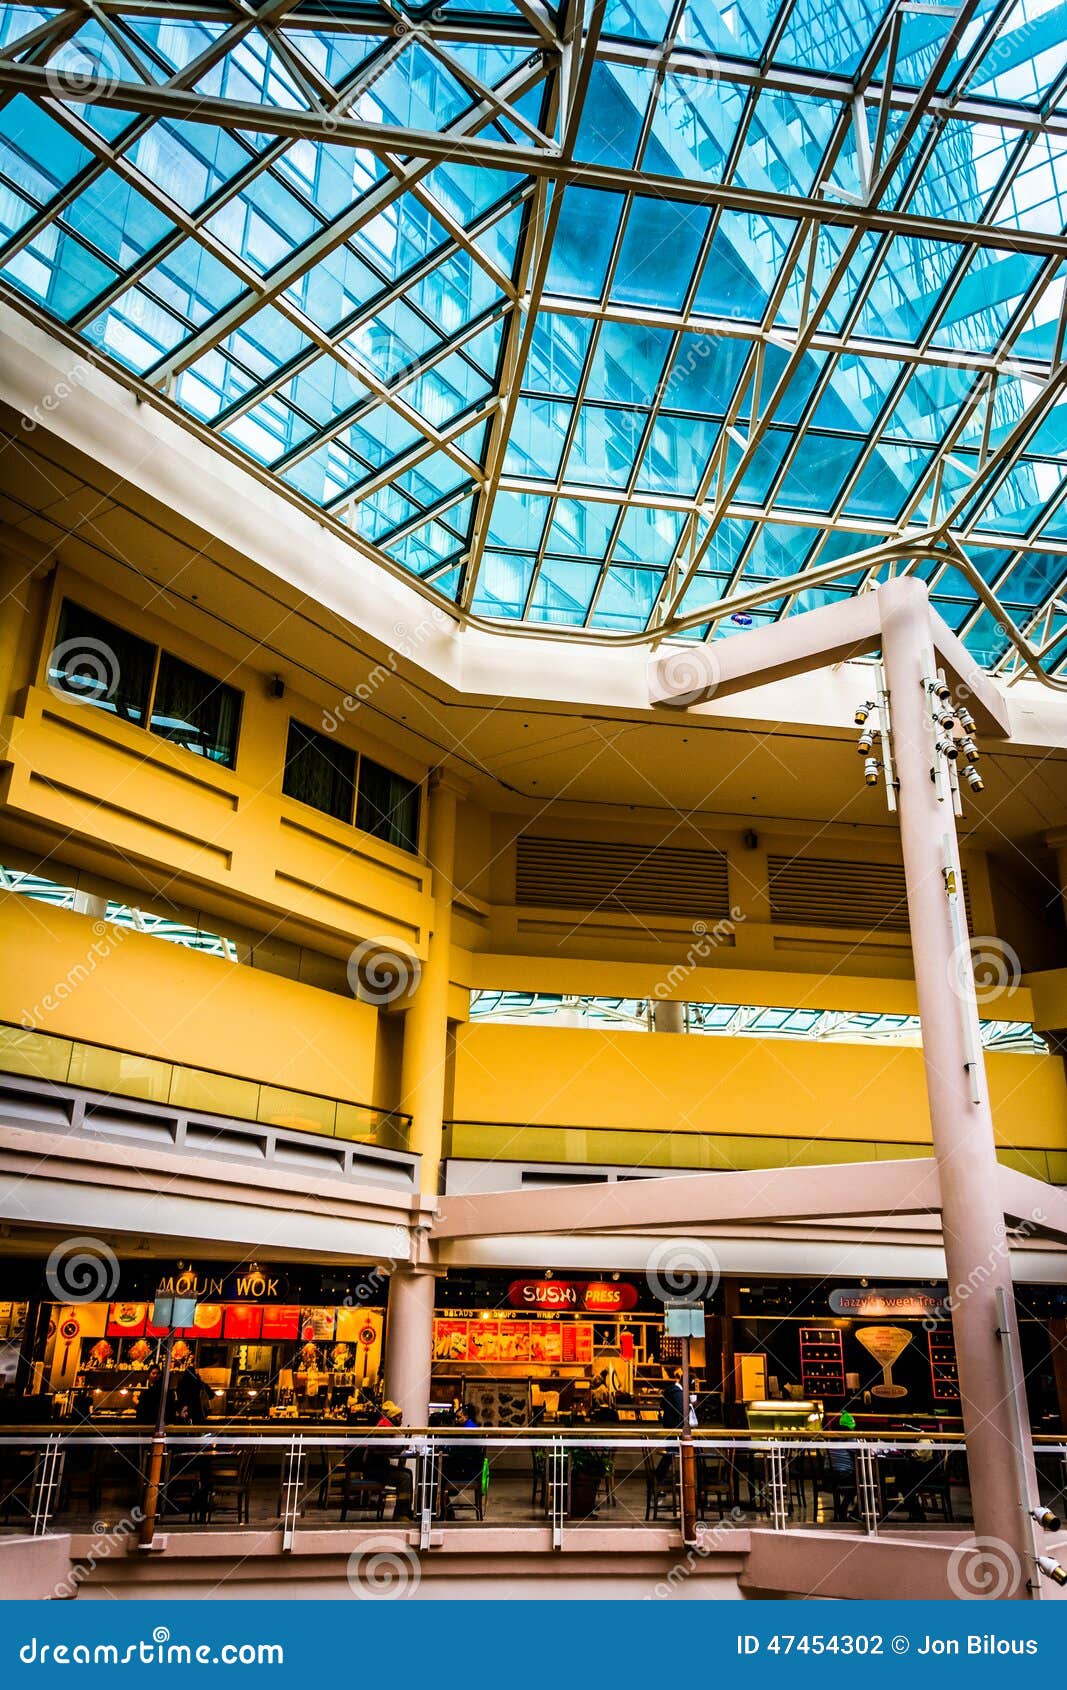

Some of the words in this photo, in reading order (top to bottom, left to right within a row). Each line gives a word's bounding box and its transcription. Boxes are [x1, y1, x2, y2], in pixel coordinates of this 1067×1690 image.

[236, 1278, 279, 1297] WOK
[523, 1286, 577, 1303] SUSHI
[585, 1290, 621, 1303] PRESS
[879, 1296, 915, 1307] Sweet
[916, 1295, 946, 1307] Trea
